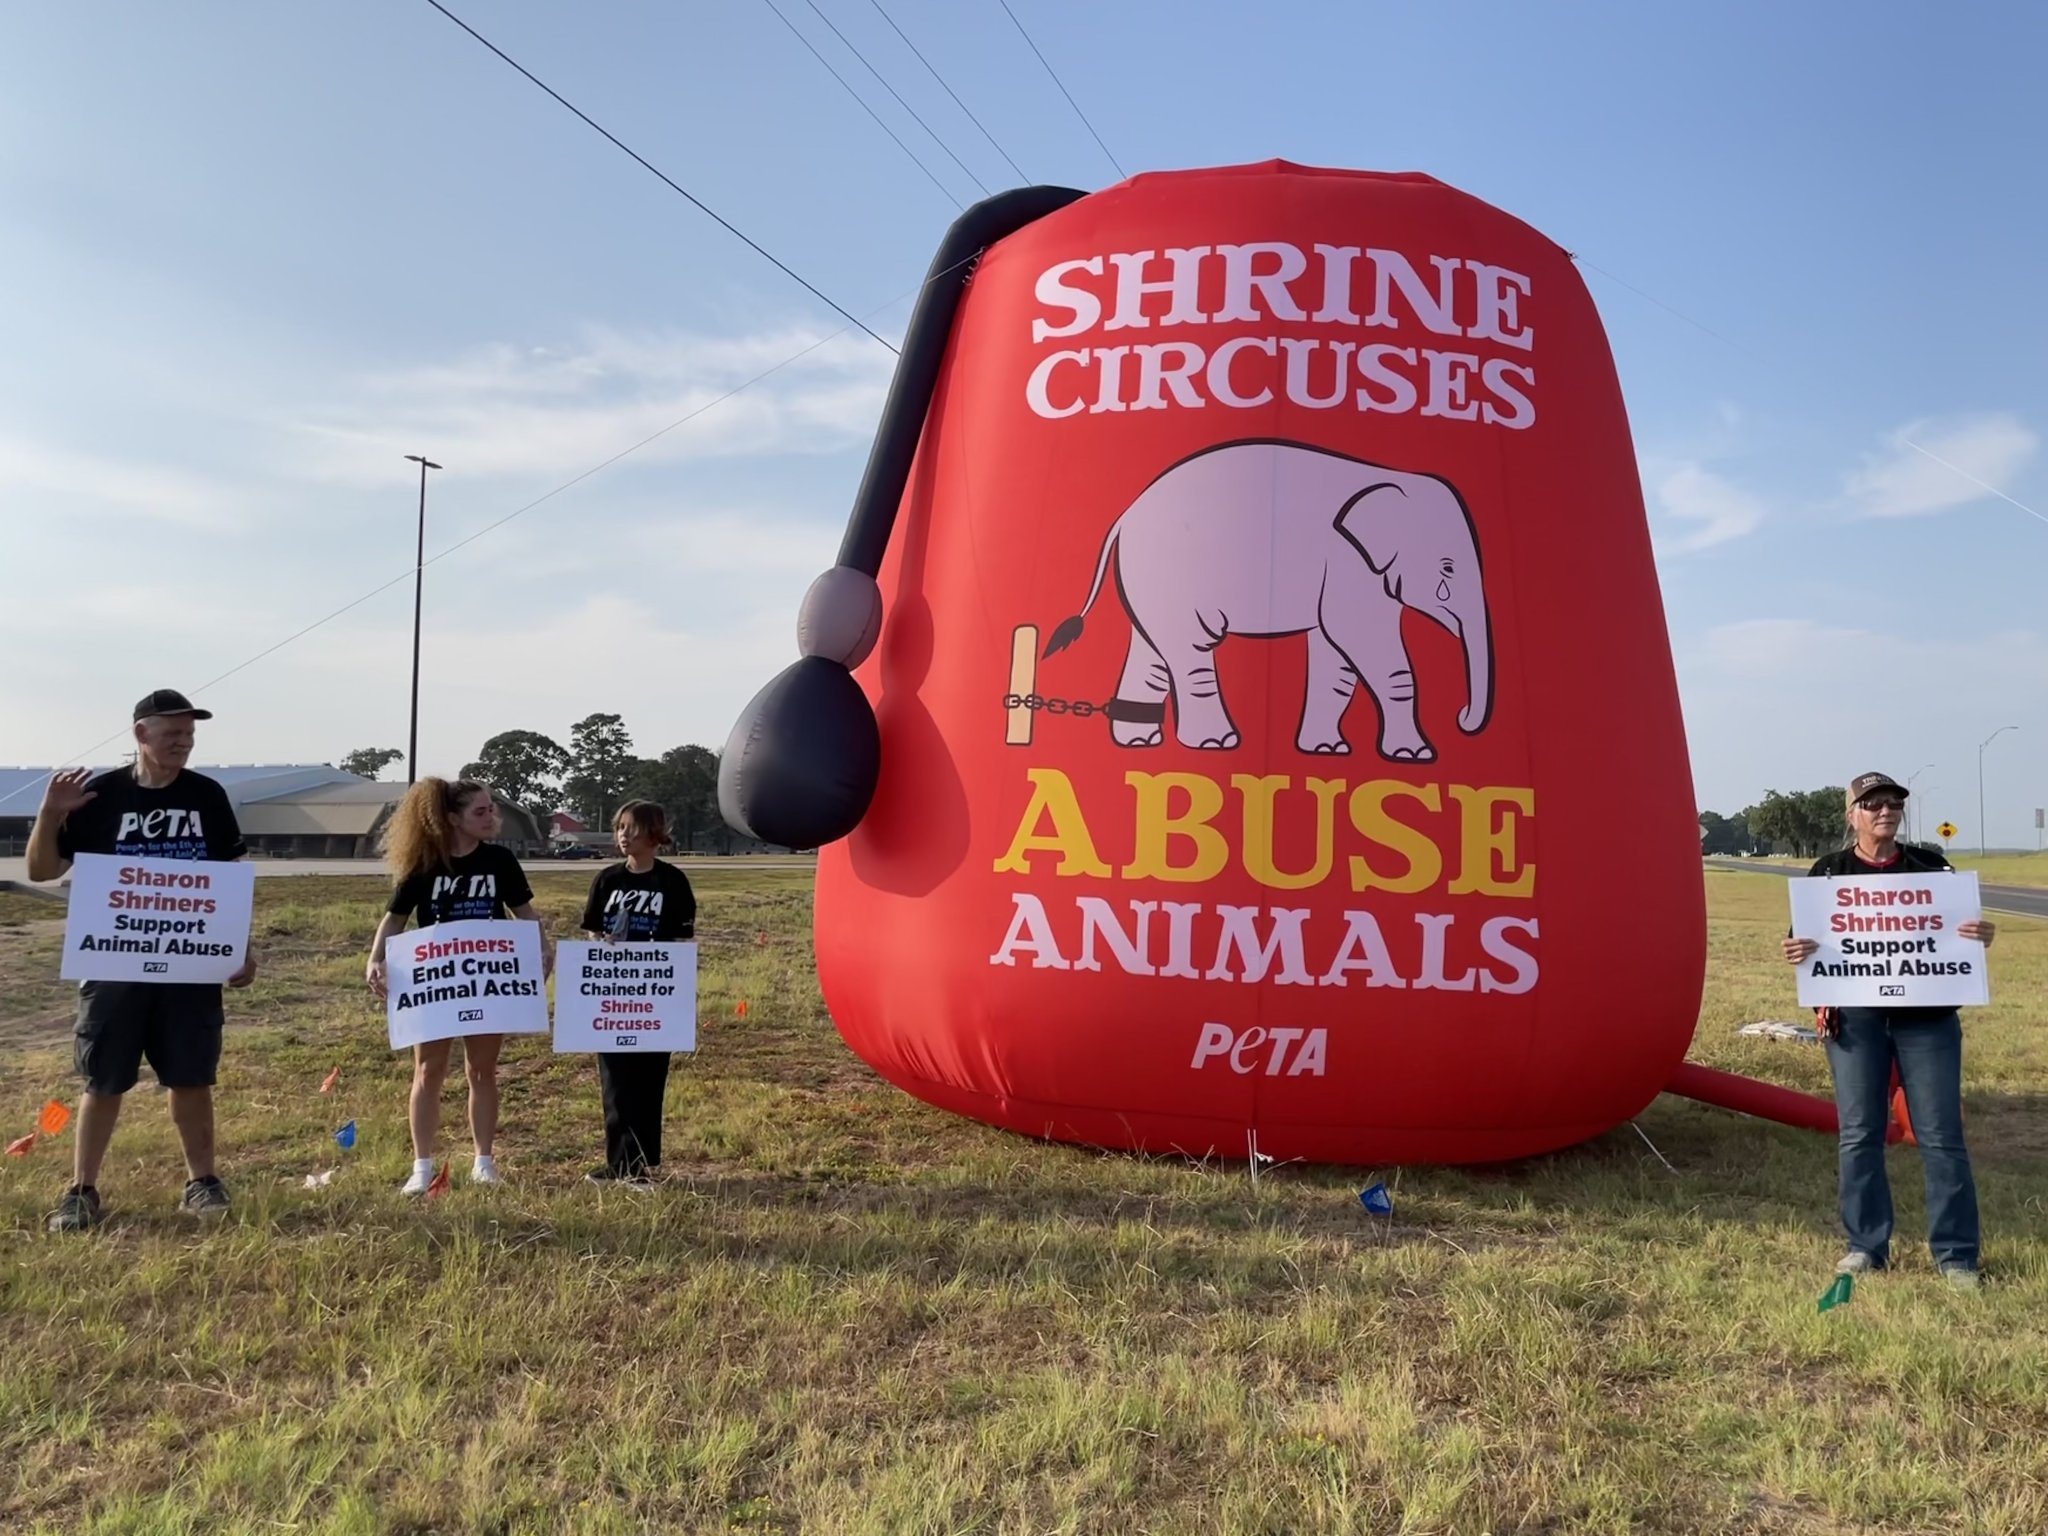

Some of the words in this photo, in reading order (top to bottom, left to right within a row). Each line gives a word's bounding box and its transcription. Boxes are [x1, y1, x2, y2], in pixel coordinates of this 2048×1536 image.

[1032, 242, 1534, 351] SHRINE
[1026, 336, 1536, 430] CIRCUSES
[993, 768, 1536, 898] ABUSE
[180, 841, 206, 849] Ethcal
[119, 867, 210, 889] Sharon
[108, 890, 216, 913] Shriners
[1836, 887, 1932, 907] Sharon
[114, 914, 206, 935] Support
[1830, 913, 1943, 933] Shriners
[80, 935, 159, 954] Animal
[165, 938, 233, 956] Abuse
[415, 937, 514, 962] Shriners:
[990, 892, 1540, 994] ANIMALS
[1841, 937, 1936, 957] Support
[588, 949, 669, 964] Elephants
[413, 964, 455, 985] End
[461, 958, 519, 976] Cruel
[582, 966, 639, 979] Beaten
[643, 966, 673, 979] and
[1812, 960, 1891, 977] Animal
[1898, 959, 1972, 976] Abuse
[397, 984, 476, 1011] Animal
[483, 980, 538, 996] Acts!
[580, 983, 646, 996] Chained
[650, 983, 674, 996] for
[601, 1000, 653, 1013] Shrine
[593, 1018, 661, 1031] Circuses
